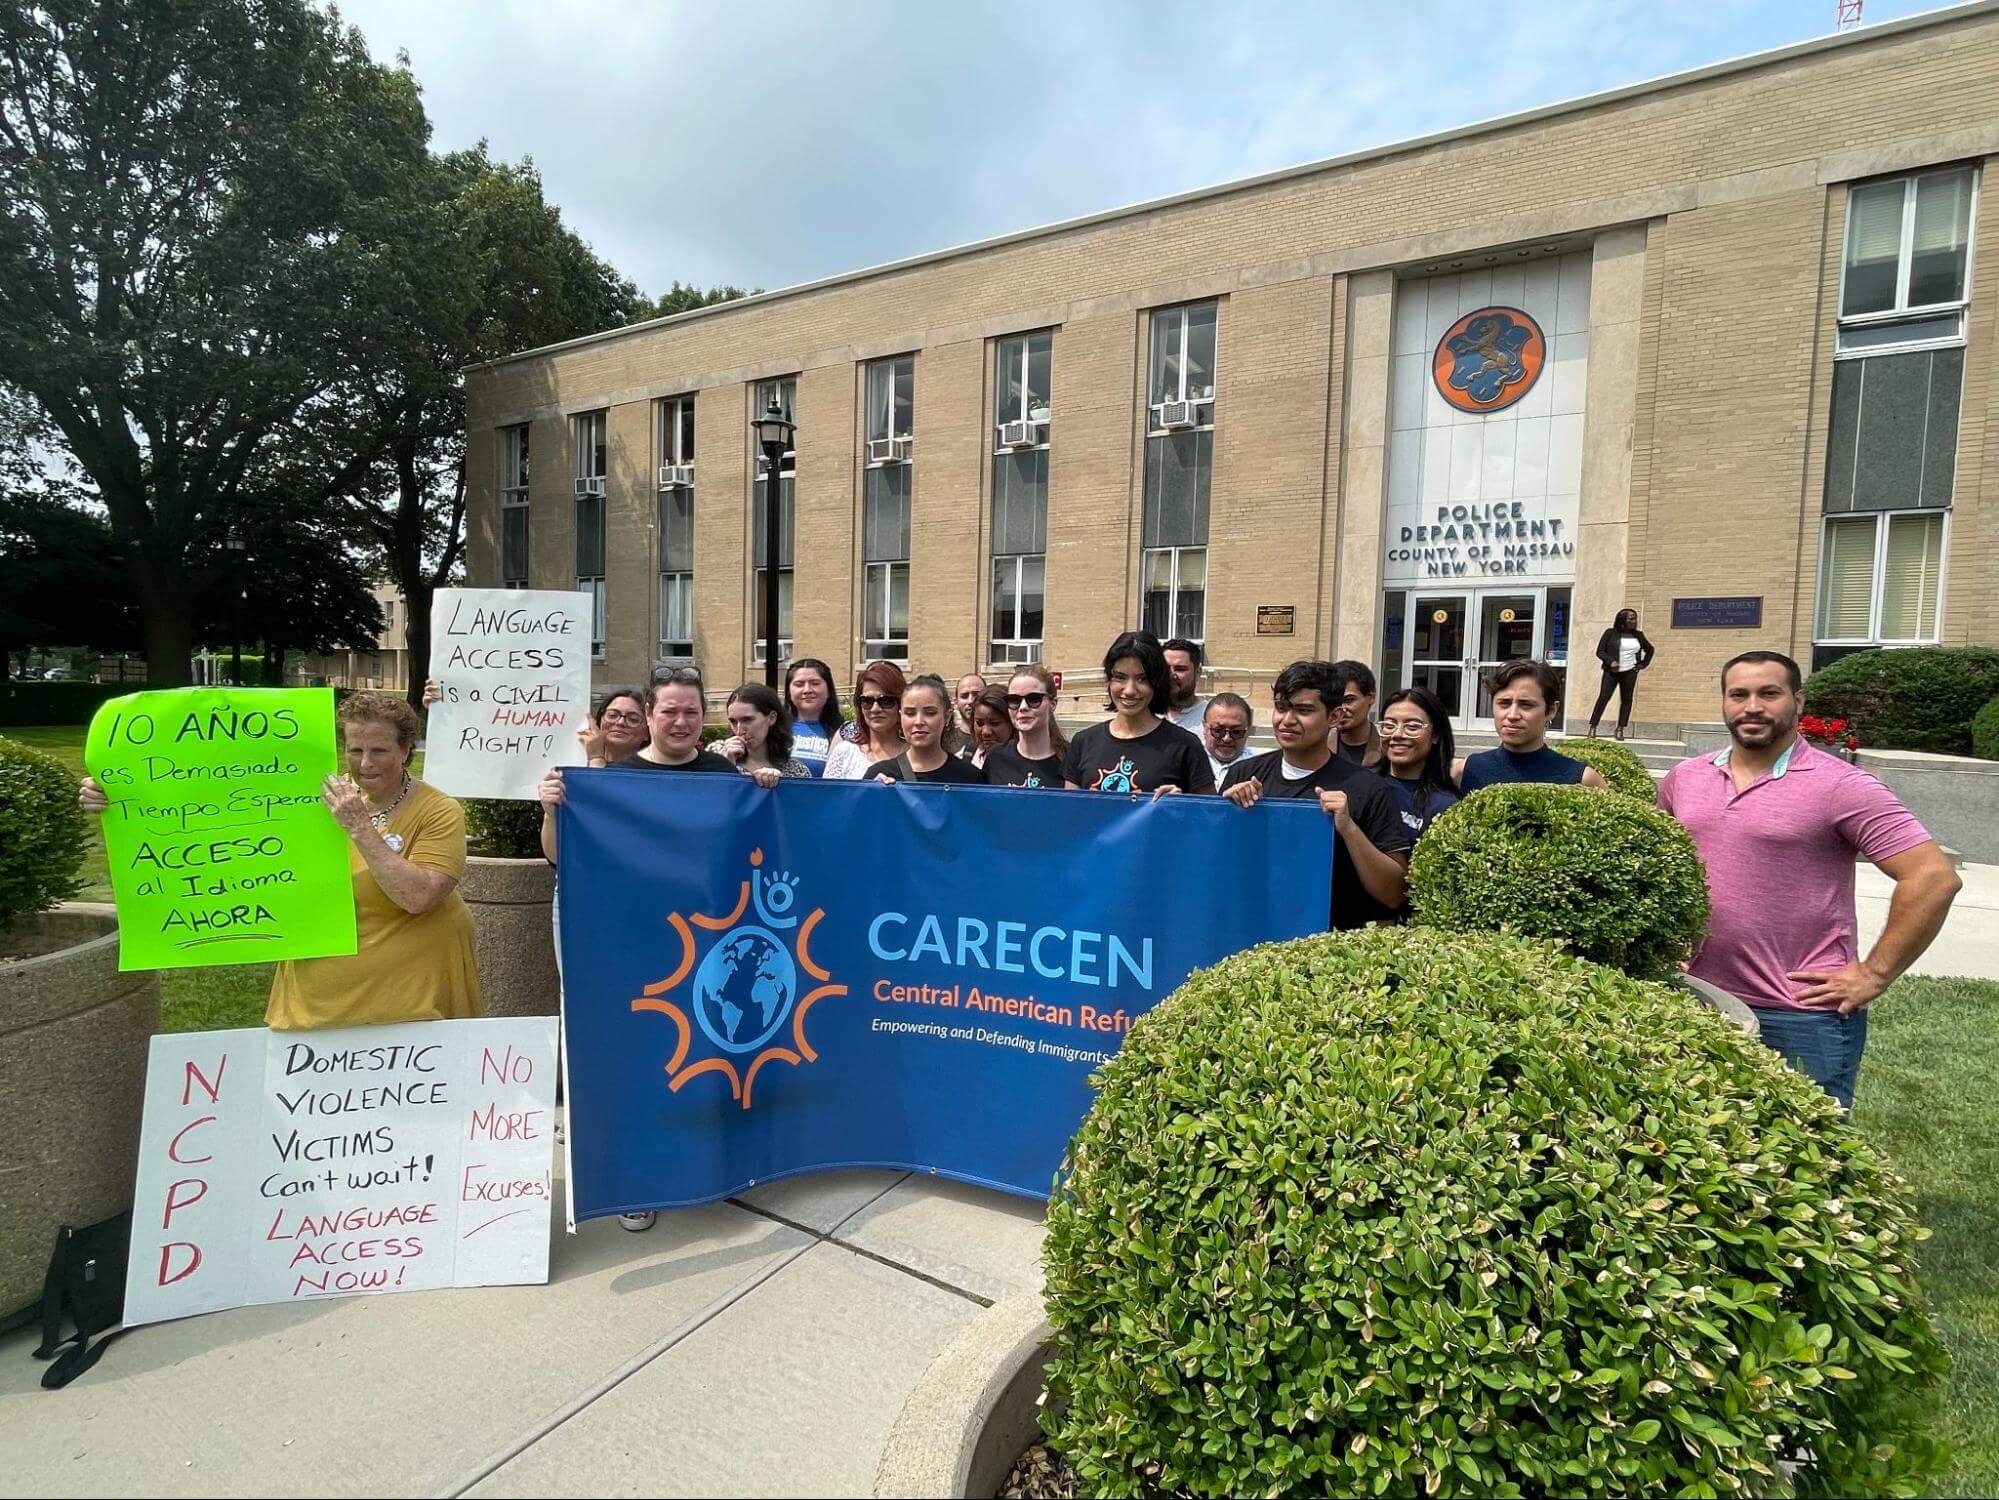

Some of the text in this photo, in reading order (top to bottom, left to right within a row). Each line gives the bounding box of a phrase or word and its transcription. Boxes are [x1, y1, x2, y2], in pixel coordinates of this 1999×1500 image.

[1438, 502, 1523, 522] POLICE
[1401, 519, 1562, 542] DEPARTMENT
[1388, 542, 1574, 561] COUNTY OF NASSAU
[1428, 559, 1526, 575] NEW YORK
[447, 598, 576, 636] LANGUAGE
[448, 644, 565, 669] ACCESS
[440, 680, 569, 705] is a CIVIL
[108, 704, 299, 748] 10 AÑOS
[491, 708, 566, 727] HUMAN
[100, 755, 298, 785] es Demasiado
[109, 798, 220, 829] Tiempo
[130, 836, 284, 870] ACCESO
[136, 870, 297, 898] al Idioma
[160, 904, 277, 933] AHORA
[868, 911, 1153, 990] CARECEN
[873, 979, 960, 1008] Central
[965, 987, 1073, 1026] American
[872, 1018, 1109, 1064] Empowering and Defending Immigrants
[482, 1044, 533, 1086] NO
[276, 1082, 448, 1115] VIOLENCE
[470, 1102, 544, 1141] MORE
[272, 1126, 394, 1163] VICTIMS
[260, 1154, 434, 1198] Can't wait!
[463, 1164, 550, 1202] Excuses!
[266, 1203, 439, 1241] LANGUAGE
[289, 1237, 423, 1269] ACCESS
[293, 1266, 406, 1297] NOW!
